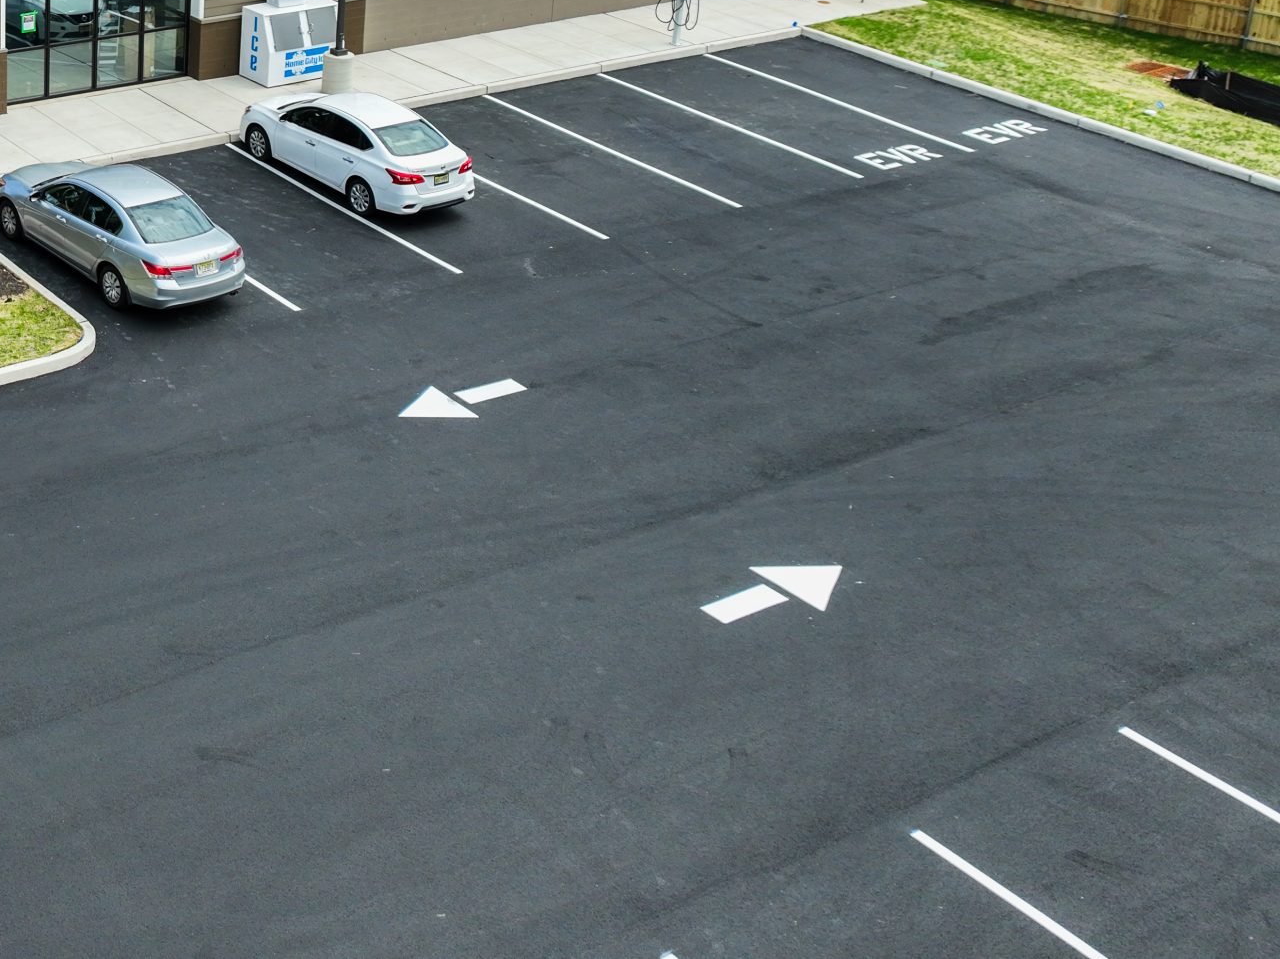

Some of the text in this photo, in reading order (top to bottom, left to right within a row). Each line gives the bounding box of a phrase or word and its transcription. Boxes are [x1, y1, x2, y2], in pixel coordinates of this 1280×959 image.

[284, 58, 304, 68] Home
[961, 119, 1049, 145] EVR
[853, 144, 944, 170] EVR
